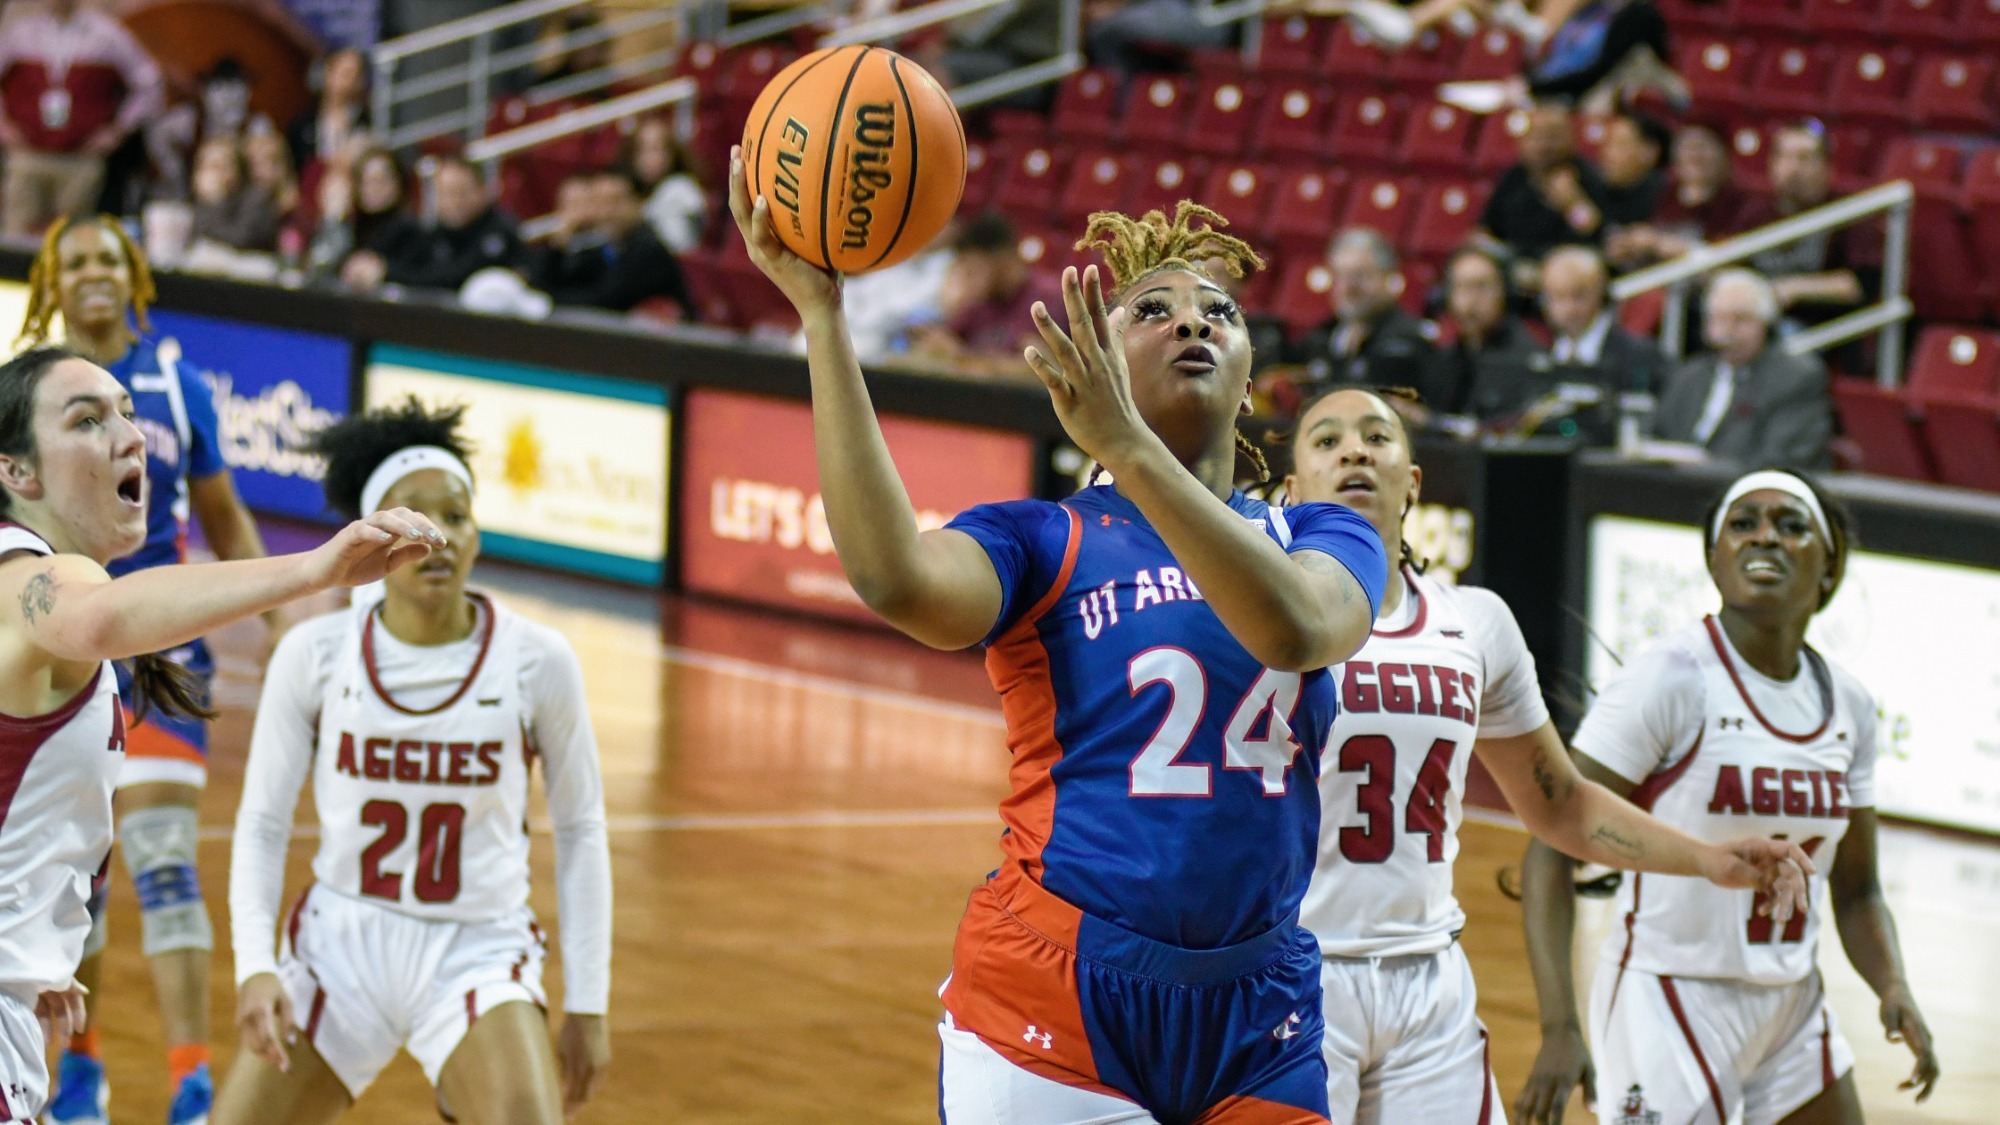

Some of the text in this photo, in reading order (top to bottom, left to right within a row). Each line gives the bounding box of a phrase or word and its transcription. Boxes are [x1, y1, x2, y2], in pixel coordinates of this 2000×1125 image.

[838, 101, 896, 252] Wilson
[1127, 645, 1303, 798] 24
[1337, 660, 1477, 727] GGIES
[336, 730, 504, 787] AGGIES
[1338, 734, 1457, 864] 34
[1707, 764, 1850, 819] AGGIE
[360, 798, 466, 905] 20
